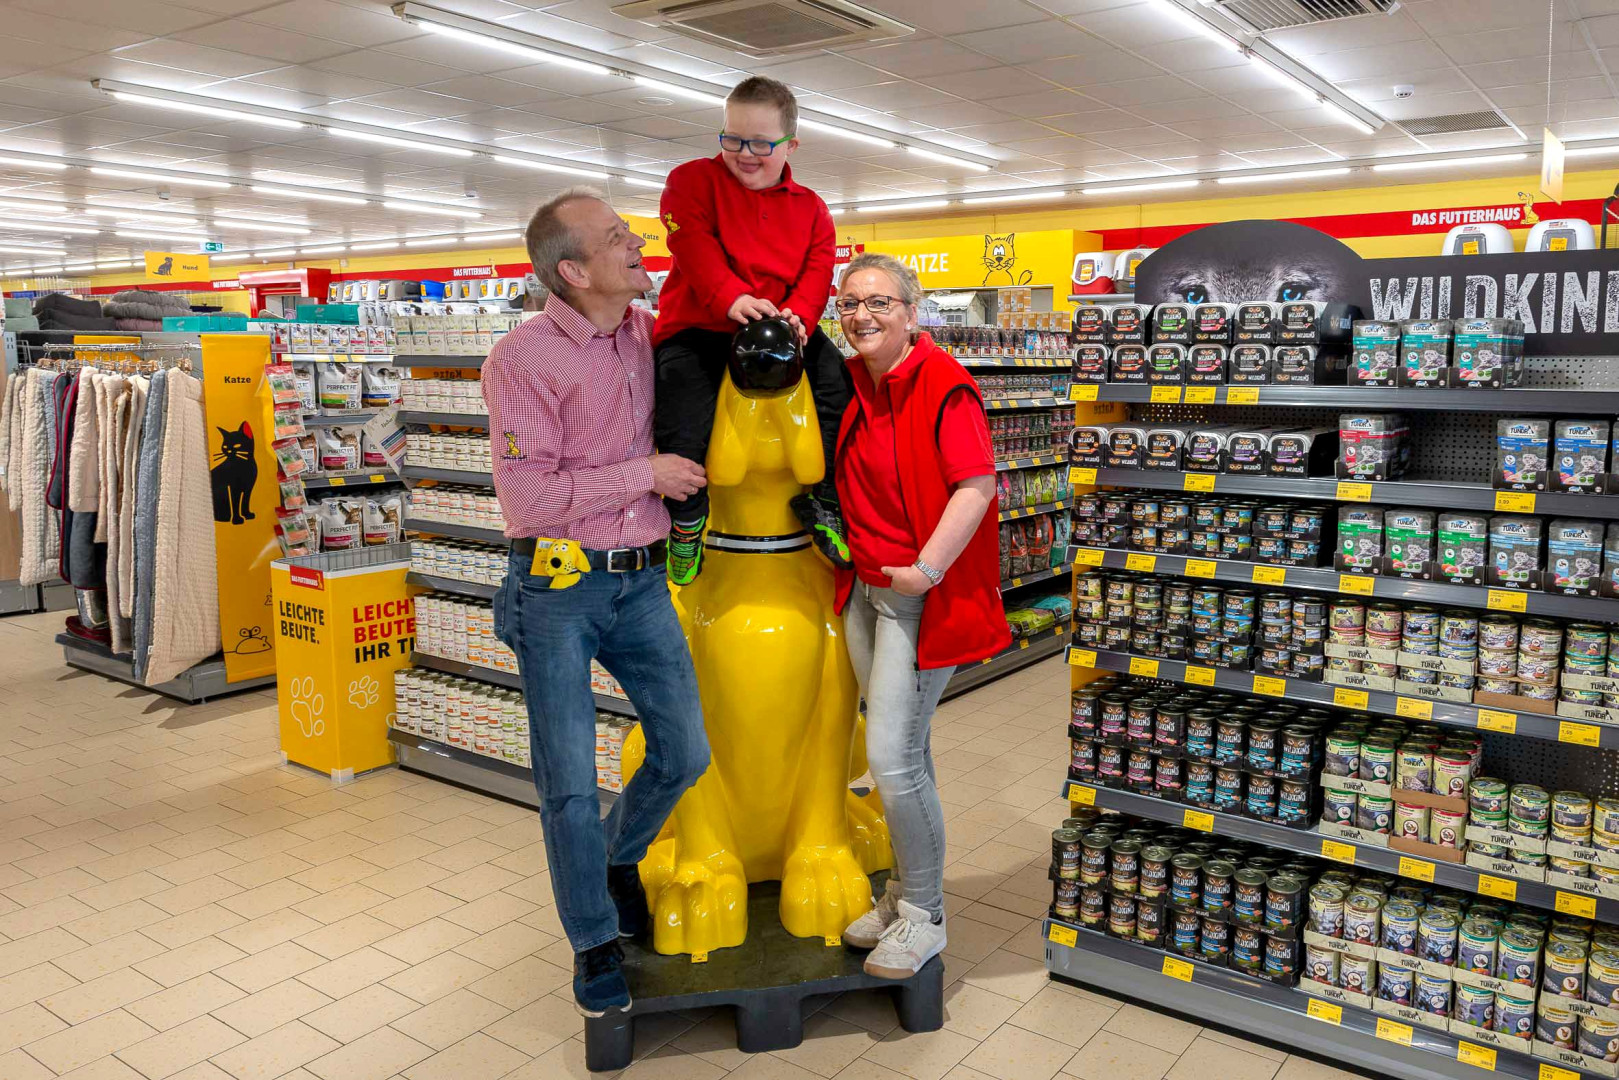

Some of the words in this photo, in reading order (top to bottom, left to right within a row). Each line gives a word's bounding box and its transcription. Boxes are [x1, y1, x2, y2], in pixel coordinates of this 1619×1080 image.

[1412, 212, 1436, 225] DAS
[1439, 208, 1520, 225] FUTTERHAUS
[454, 268, 462, 276] DAS
[463, 267, 491, 276] FUTTERHAUS
[279, 600, 324, 626] LEICHTE
[353, 598, 414, 623] LEICH
[281, 620, 320, 644] BEUTE.
[354, 618, 416, 644] BEUTE
[355, 642, 391, 663] IHR
